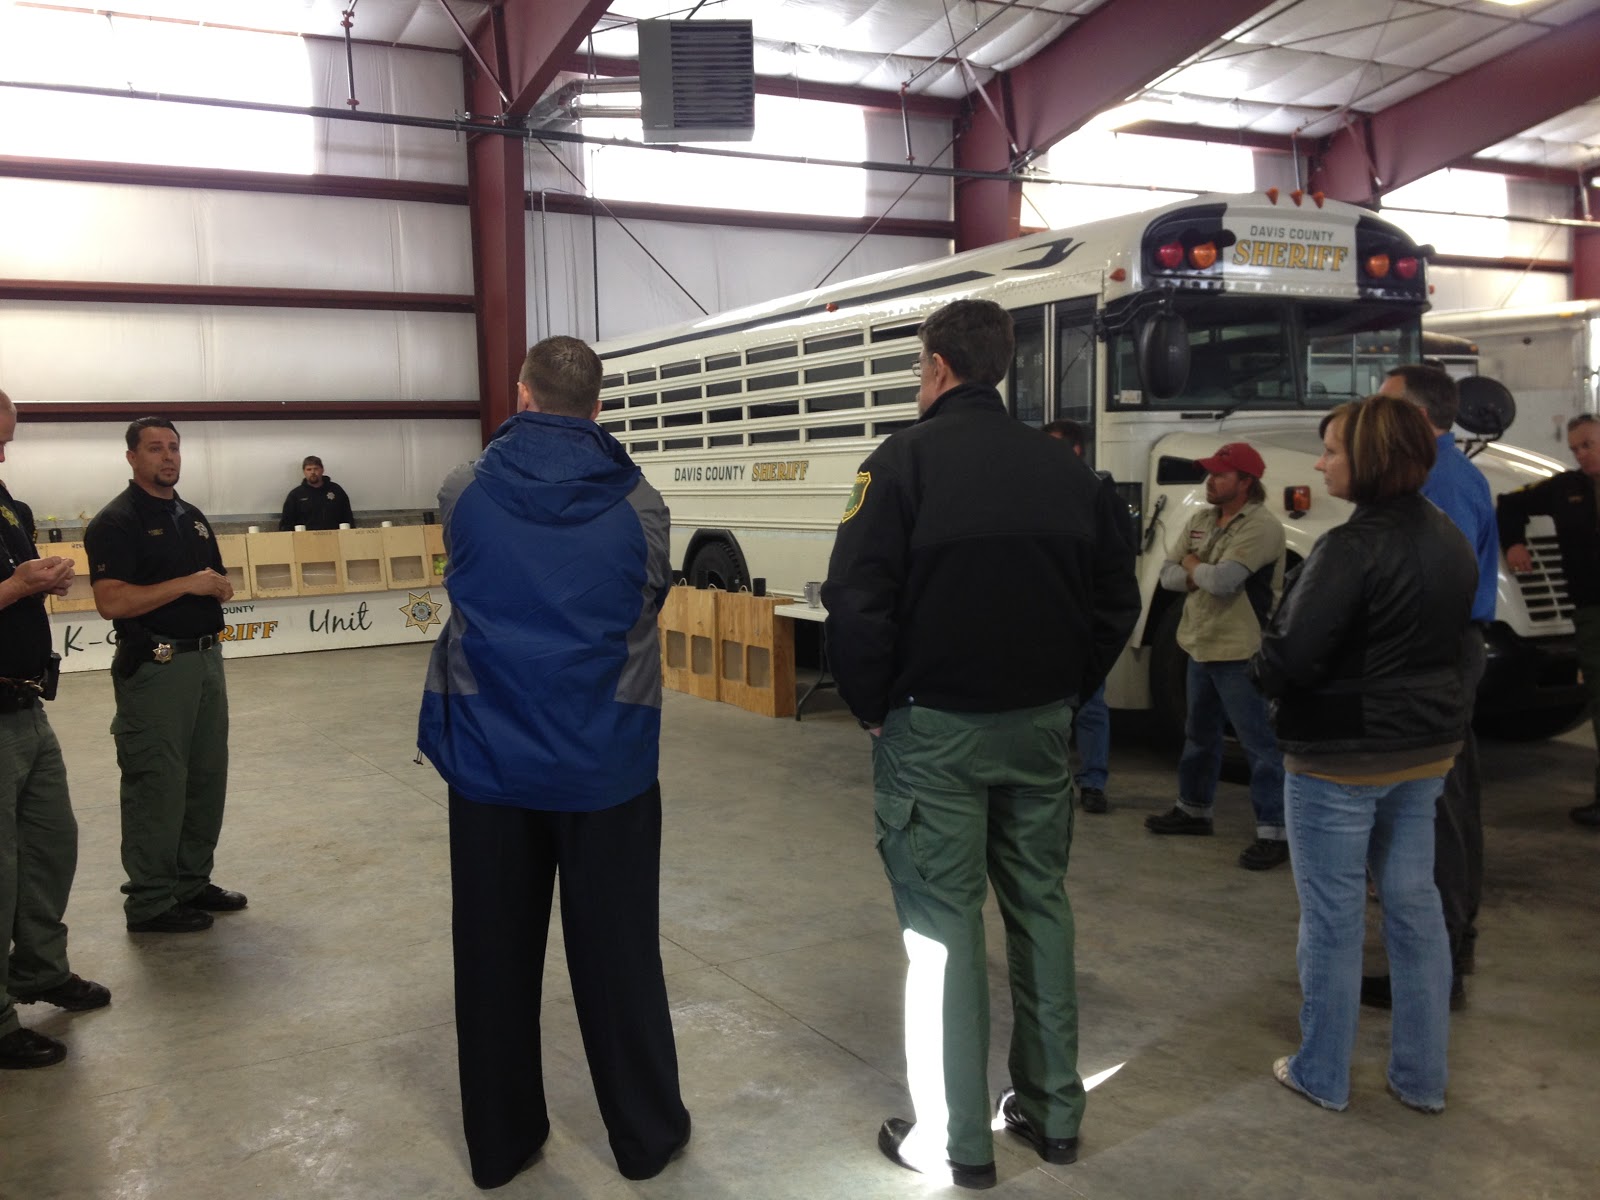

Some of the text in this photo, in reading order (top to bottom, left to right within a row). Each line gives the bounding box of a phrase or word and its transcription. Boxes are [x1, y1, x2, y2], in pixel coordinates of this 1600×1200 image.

[1250, 225, 1334, 242] DAVIS COUNTY
[1232, 239, 1349, 272] SHERIFF
[674, 460, 809, 482] DAVIS COUNTY SHERIFF
[221, 604, 255, 615] OUNTY
[218, 620, 279, 643] RIFF
[309, 601, 373, 634] Unit
